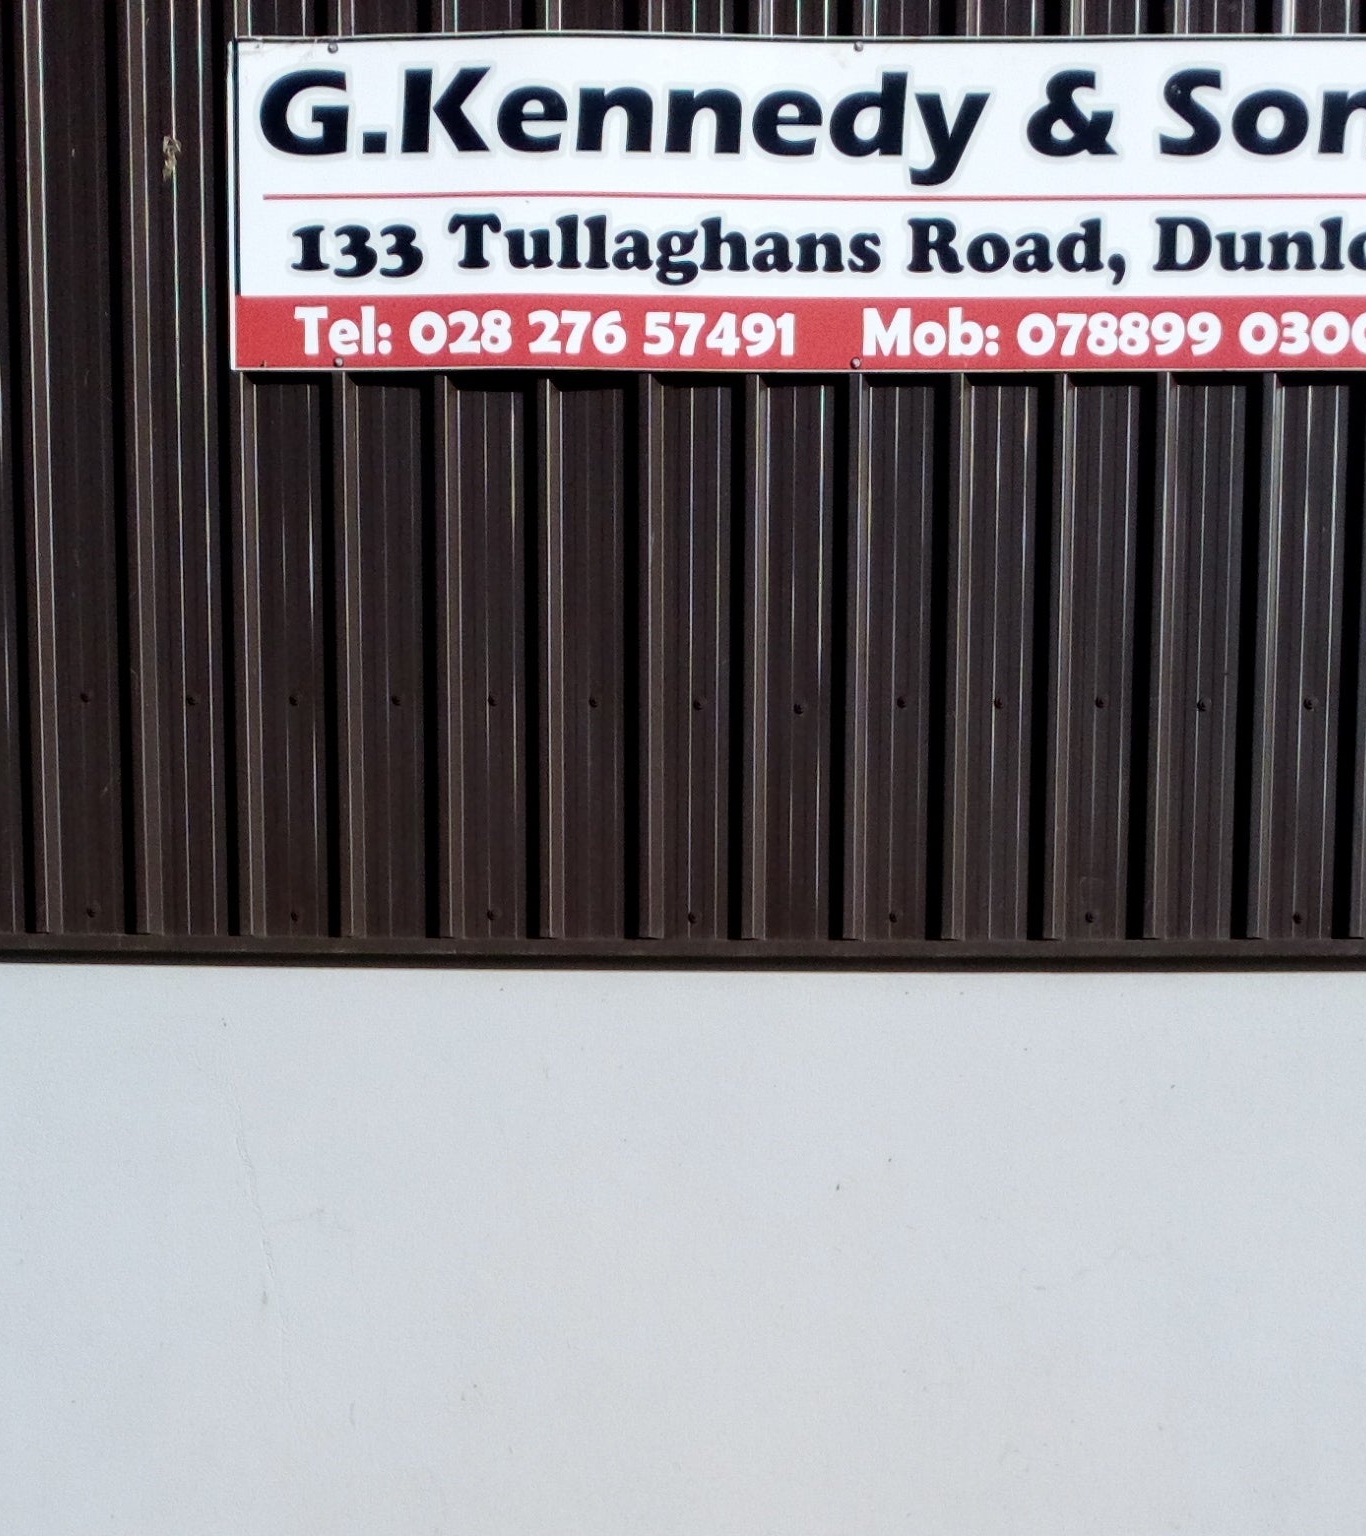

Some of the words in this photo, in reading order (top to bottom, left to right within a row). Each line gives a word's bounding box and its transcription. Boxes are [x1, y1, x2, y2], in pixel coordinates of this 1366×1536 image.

[1027, 70, 1117, 157] &
[292, 225, 424, 278] 133
[447, 214, 881, 286] Tullaghans
[908, 218, 1126, 285] Road,
[293, 305, 392, 356] Tel:
[408, 310, 513, 355] 028
[528, 309, 627, 355] 276
[643, 311, 796, 357] 57491
[862, 306, 1000, 357] Mob:
[1016, 311, 1222, 357] 078899
